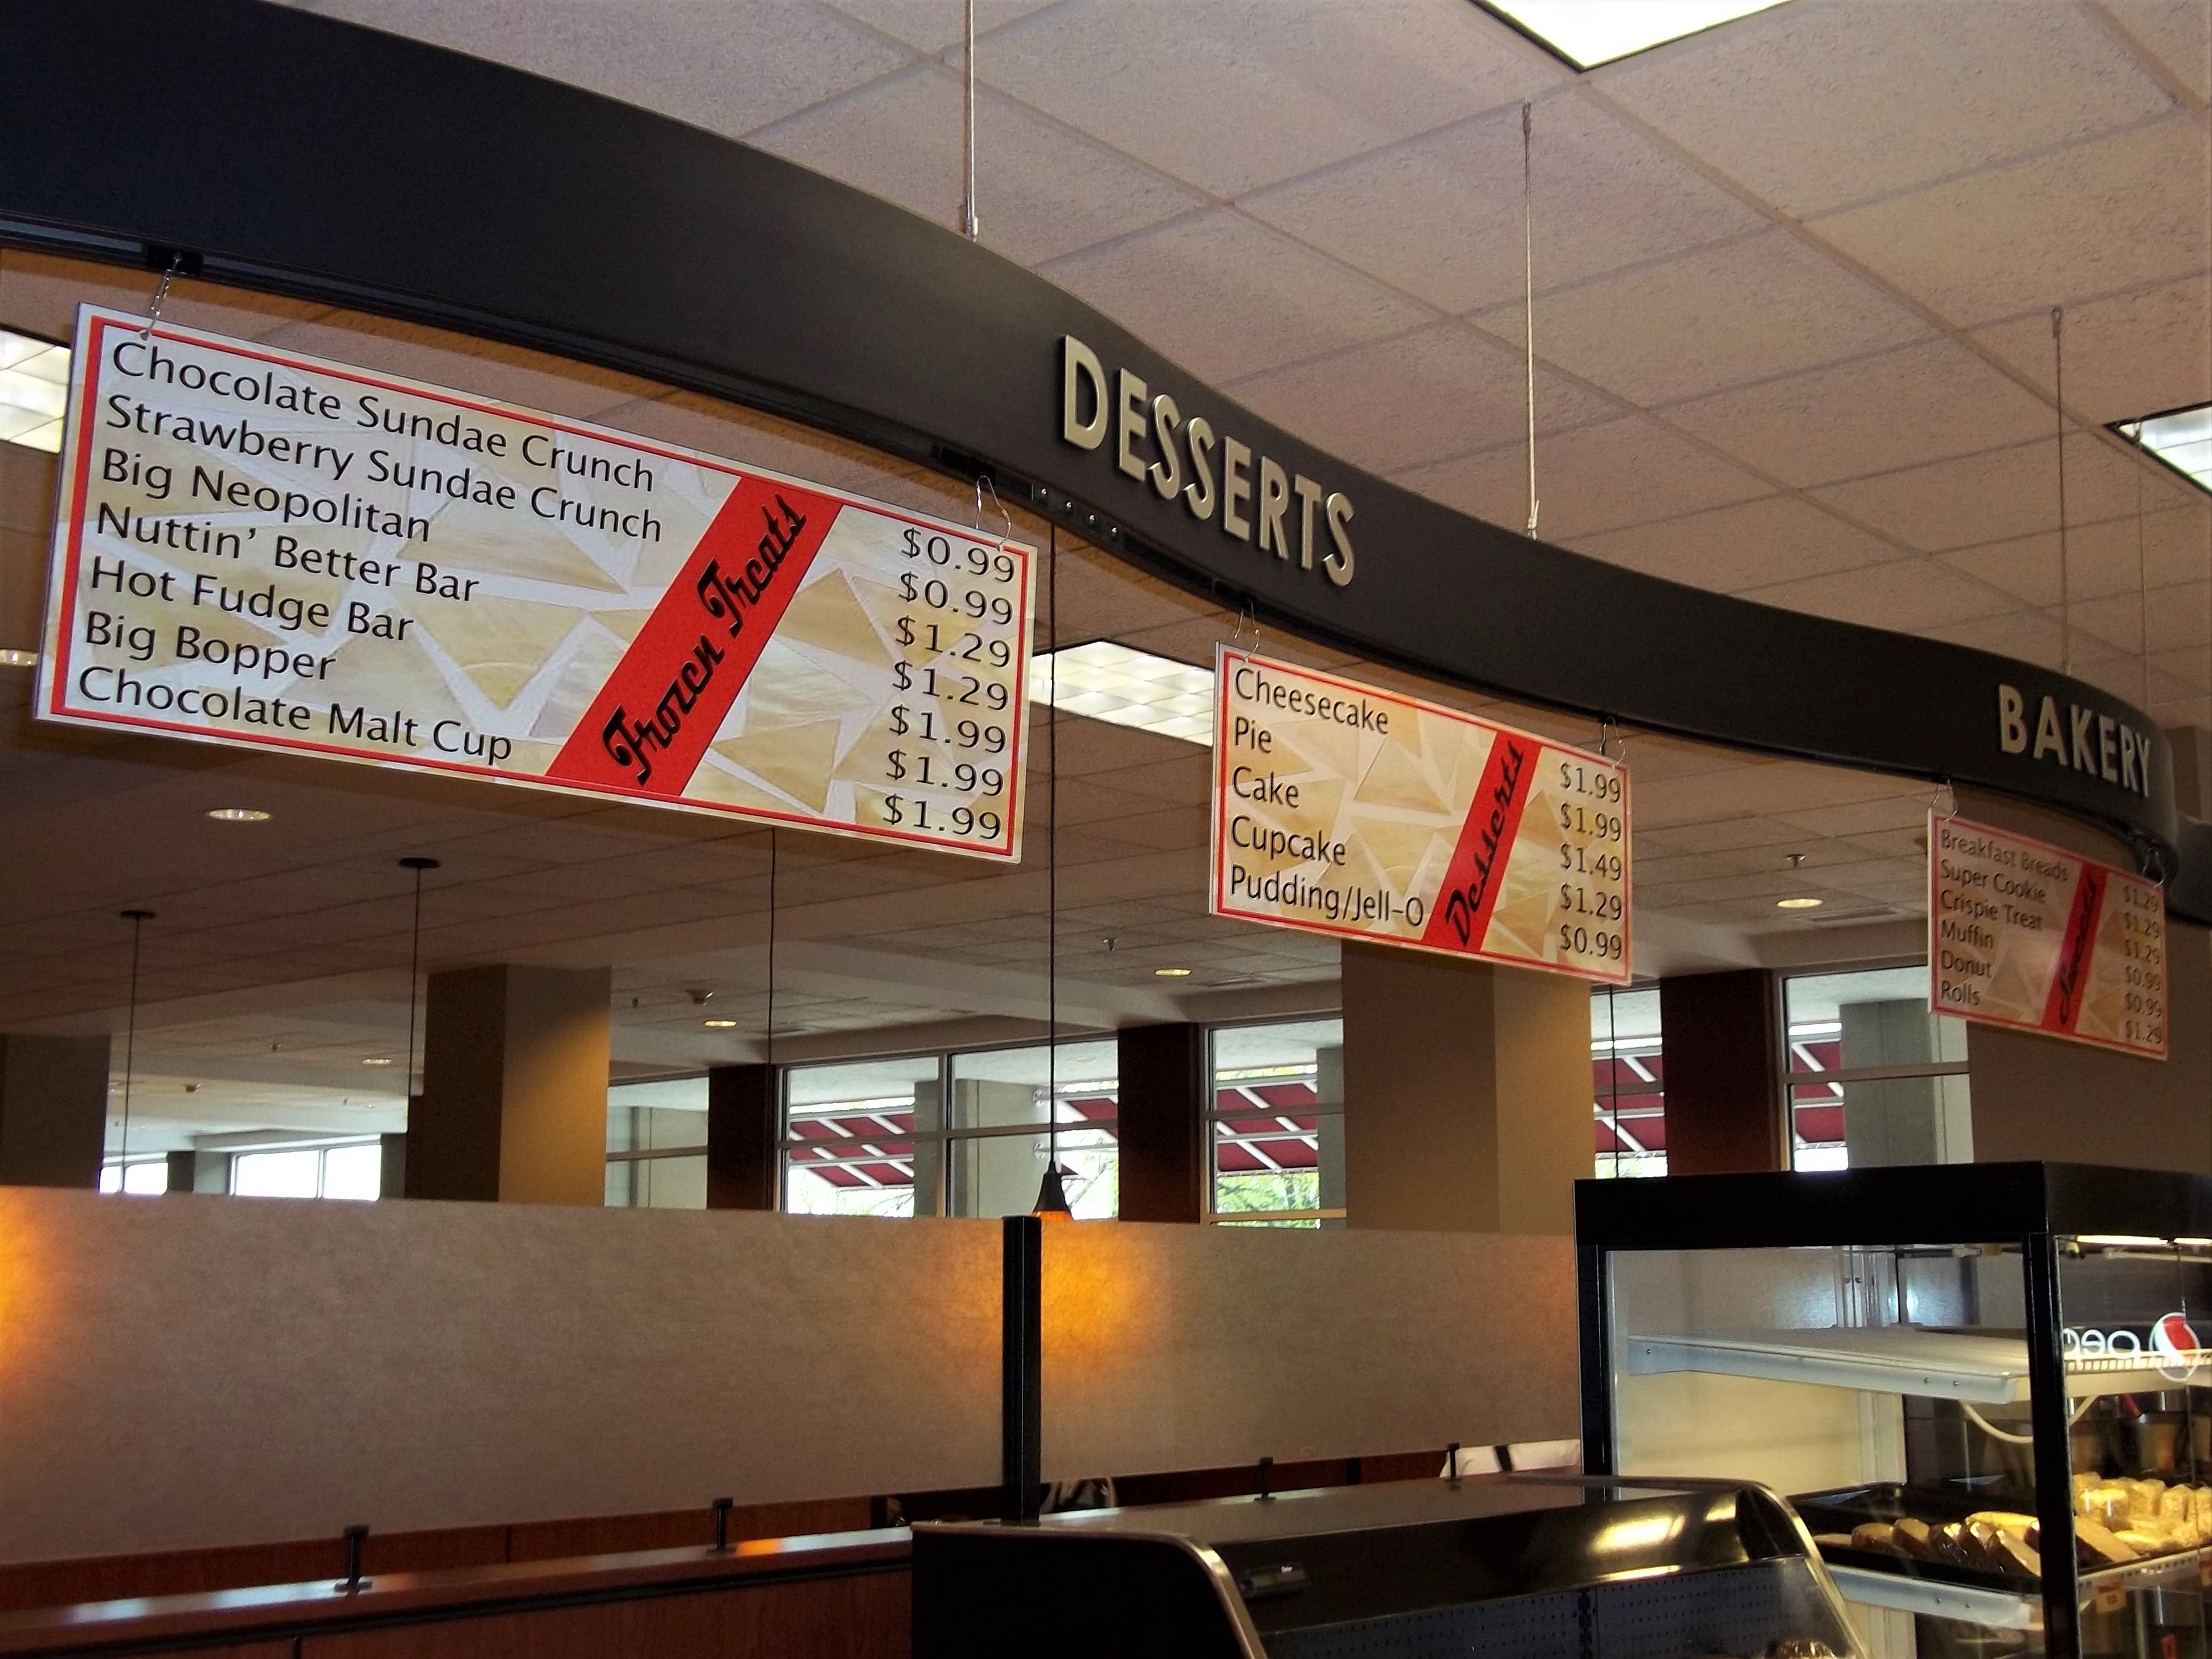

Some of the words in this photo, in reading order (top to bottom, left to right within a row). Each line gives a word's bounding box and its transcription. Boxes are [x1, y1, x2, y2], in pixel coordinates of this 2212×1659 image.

[113, 341, 341, 419] Chocolate
[357, 395, 507, 456] Sundae
[521, 434, 653, 492] Crunch
[107, 394, 353, 479] Strawberry
[369, 450, 516, 510] Sundae
[530, 488, 662, 543] Crunch
[1064, 334, 1355, 587] DESSERTS
[102, 448, 172, 498] Big
[191, 465, 430, 542] Neopolitan
[274, 536, 401, 587] Better
[416, 563, 480, 603] Bar
[901, 527, 1016, 583] $0.99
[91, 555, 175, 602] Hot
[193, 573, 330, 634] Fudge
[347, 601, 414, 641] Bar
[898, 571, 1013, 626] $0.99
[85, 611, 156, 660] Big
[175, 626, 337, 681] Bopper
[602, 633, 725, 786] Frozen
[696, 492, 808, 638] Treats
[896, 615, 1011, 669] $1.29
[892, 659, 1009, 712] $1.29
[1235, 666, 1389, 735] Cheesecake
[78, 665, 310, 730] Chocolate
[329, 702, 417, 747] Malt
[433, 718, 512, 767] Cup
[889, 704, 1007, 754] $1.99
[1233, 716, 1273, 754] Pie
[1999, 684, 2150, 798] BAKERY
[886, 749, 1004, 797] $1.99
[1232, 766, 1300, 808] Cake
[1560, 762, 1622, 803] $1.99
[882, 794, 1001, 840] $1.99
[1231, 815, 1346, 867] Cupcake
[1560, 803, 1622, 843] $1.99
[1445, 741, 1523, 948] Desserts
[1560, 843, 1622, 881] $1.49
[1941, 828, 2015, 867] Breakfast
[2022, 851, 2068, 882] Breads
[1230, 864, 1424, 927] Pudding/Jell-O
[1560, 883, 1623, 921] $1.29
[1941, 858, 1988, 888] Super
[1994, 872, 2046, 904] Cookie
[1941, 889, 1998, 921] Crispie
[2002, 904, 2042, 931] Treat
[1941, 918, 1993, 949] Muffin
[1559, 924, 1622, 961] $0.99
[1941, 950, 1993, 979] Donut
[1941, 980, 1981, 1006] Rolls
